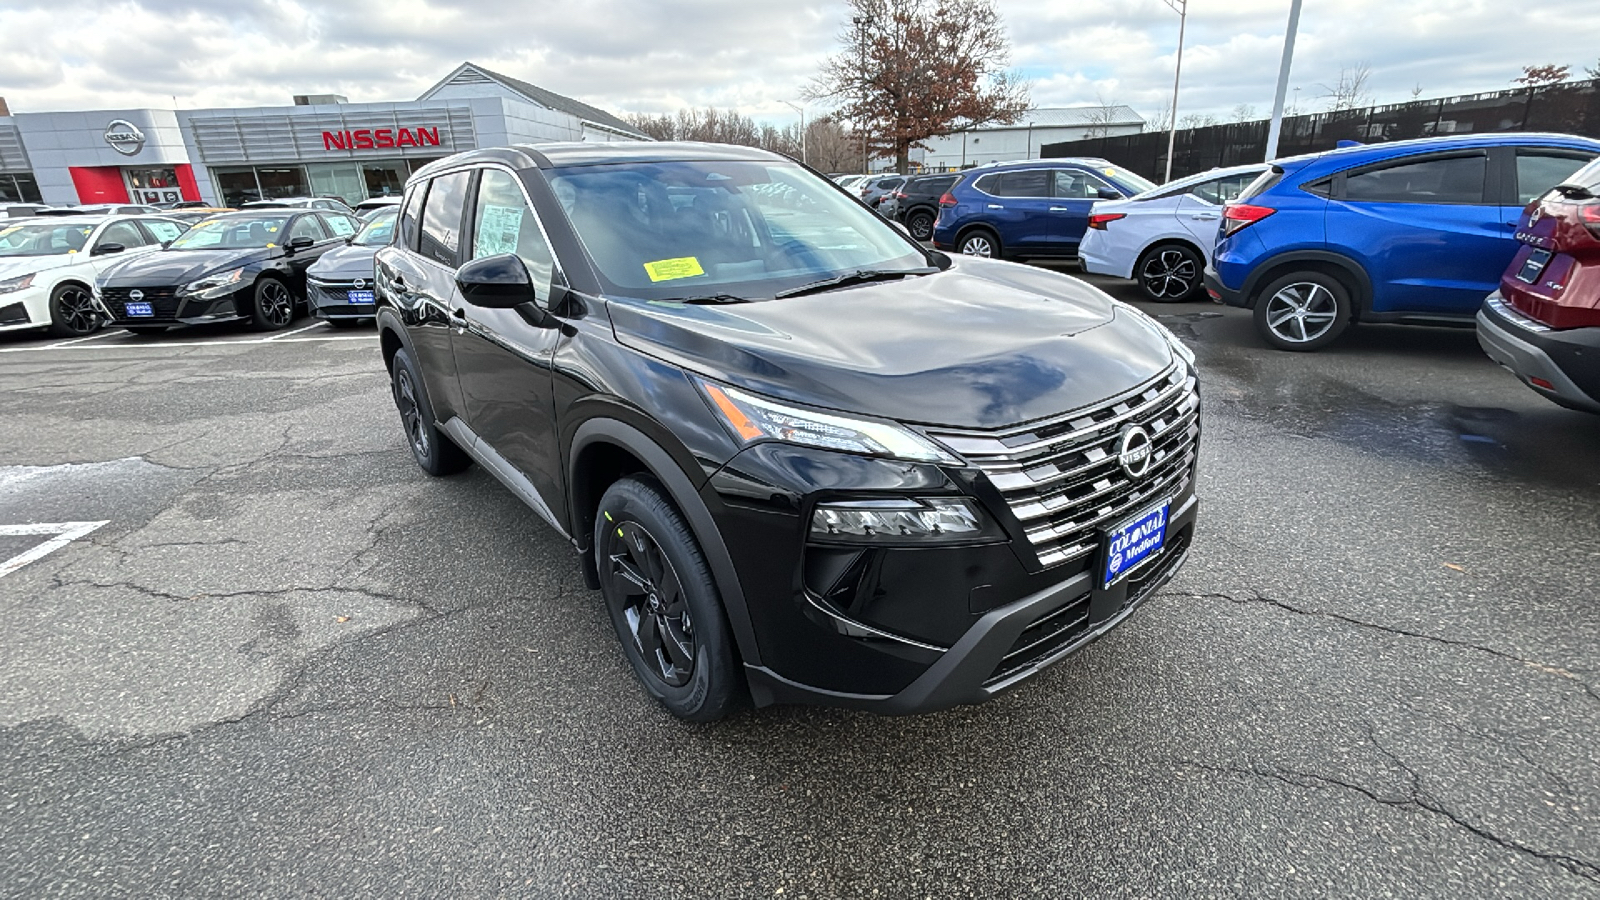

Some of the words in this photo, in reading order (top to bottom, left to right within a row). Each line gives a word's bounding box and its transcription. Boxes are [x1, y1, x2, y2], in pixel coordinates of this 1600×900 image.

[321, 126, 440, 151] NISSAN
[1109, 514, 1166, 557] COLONIAL
[1125, 531, 1161, 562] Medford
